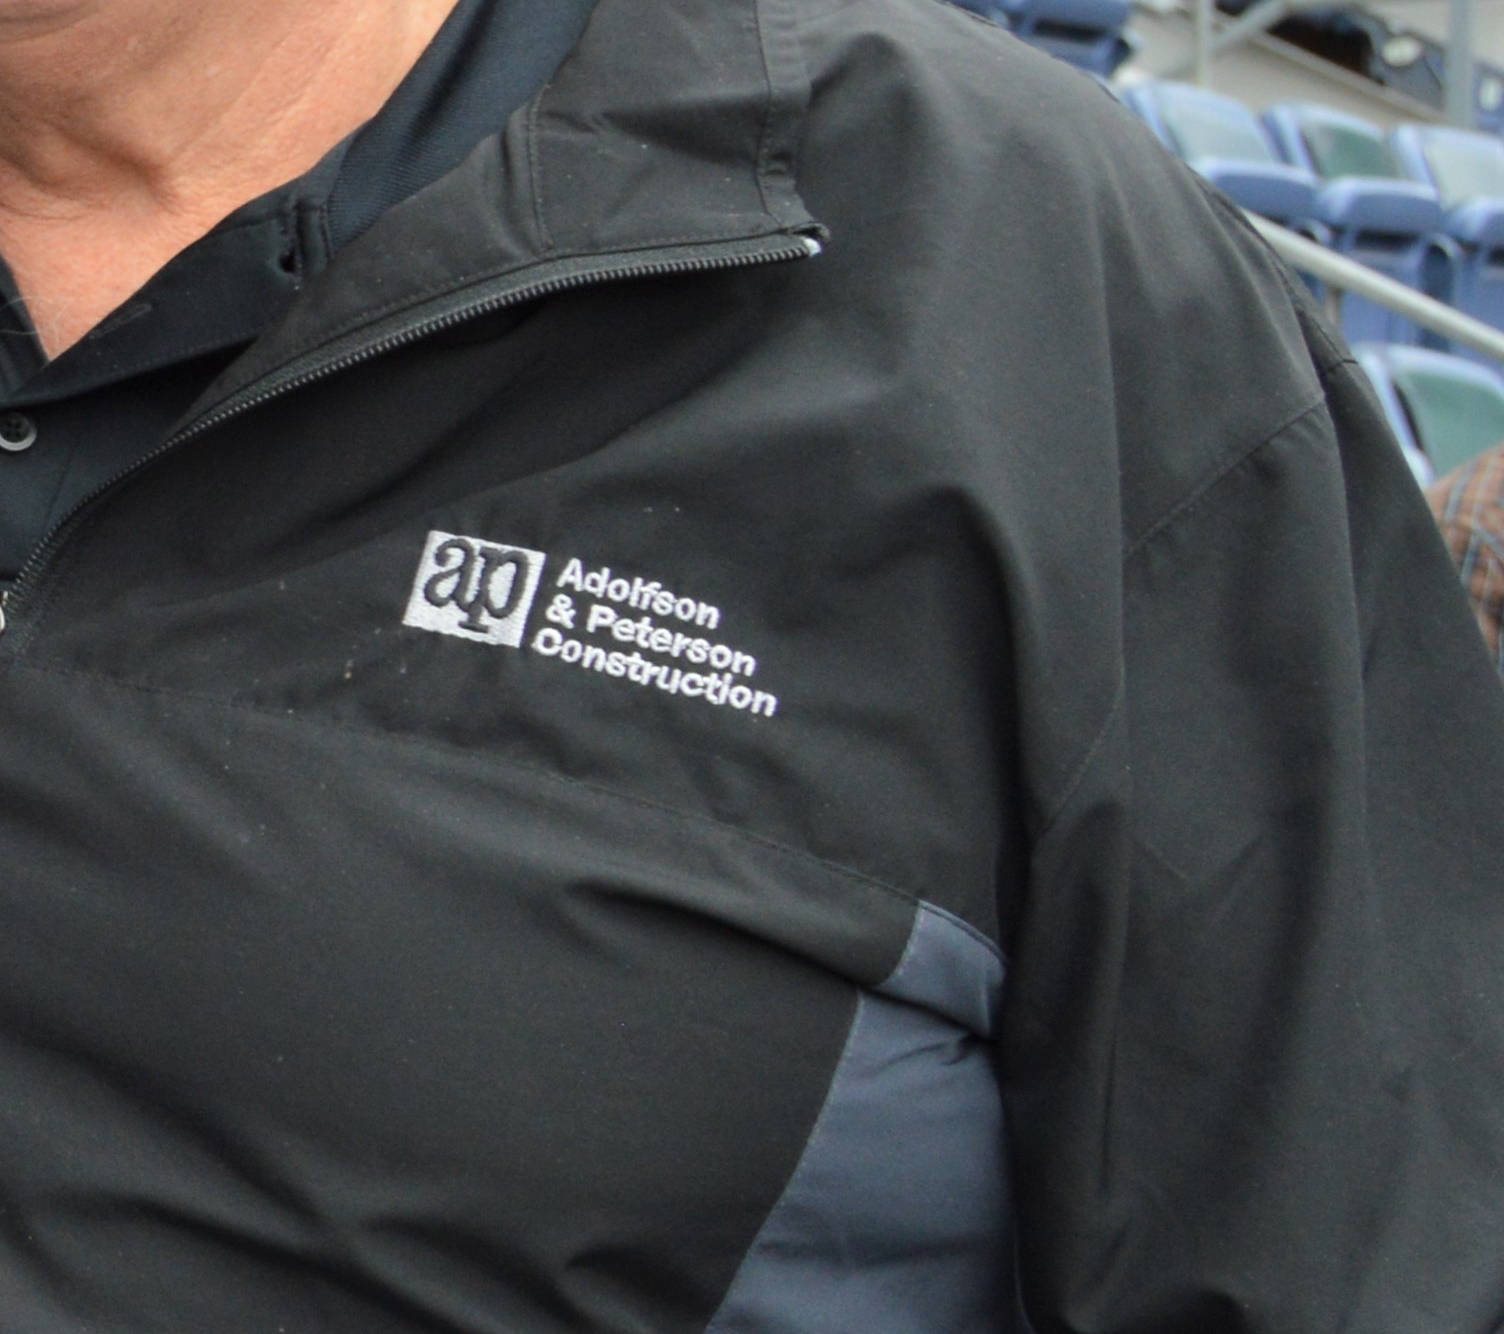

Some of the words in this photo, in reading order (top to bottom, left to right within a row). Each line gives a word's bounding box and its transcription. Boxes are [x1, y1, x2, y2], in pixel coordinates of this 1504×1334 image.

[544, 593, 577, 630] &
[586, 603, 757, 678] Peterson
[556, 557, 721, 630] Adolfson
[531, 626, 779, 718] Construction
